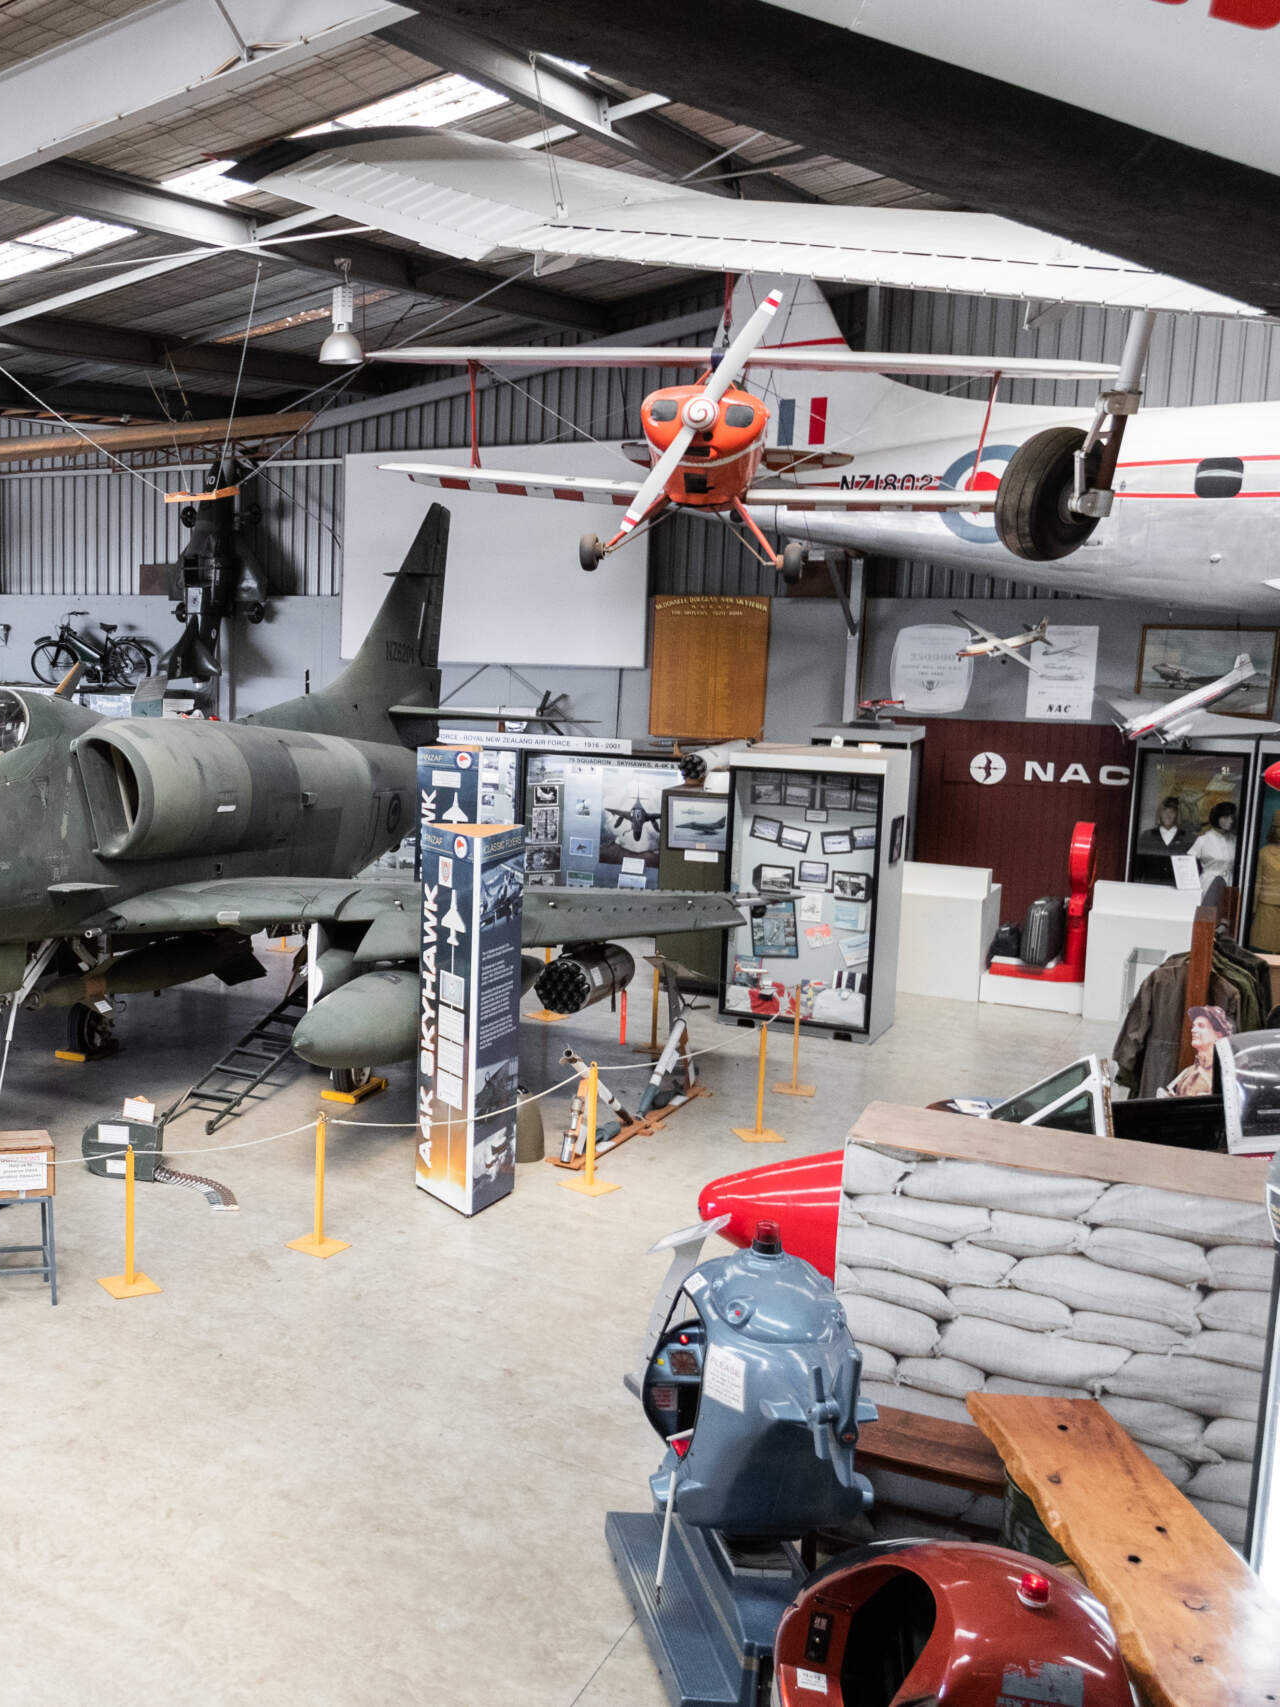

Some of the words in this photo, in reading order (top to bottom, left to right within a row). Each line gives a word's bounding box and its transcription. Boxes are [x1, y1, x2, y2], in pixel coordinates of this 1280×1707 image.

[1046, 703, 1072, 714] NAC
[463, 735, 484, 743] ROYAL
[485, 736, 501, 744] NEW
[502, 737, 534, 745] ZEALAND
[534, 738, 546, 746] AIR
[547, 739, 571, 747] FORCE
[577, 758, 612, 766] SQUADRON
[1023, 760, 1131, 786] NAC
[484, 840, 505, 854] CLASSIC
[505, 836, 522, 848] FLYERS
[420, 882, 439, 1077] SKYHAWK
